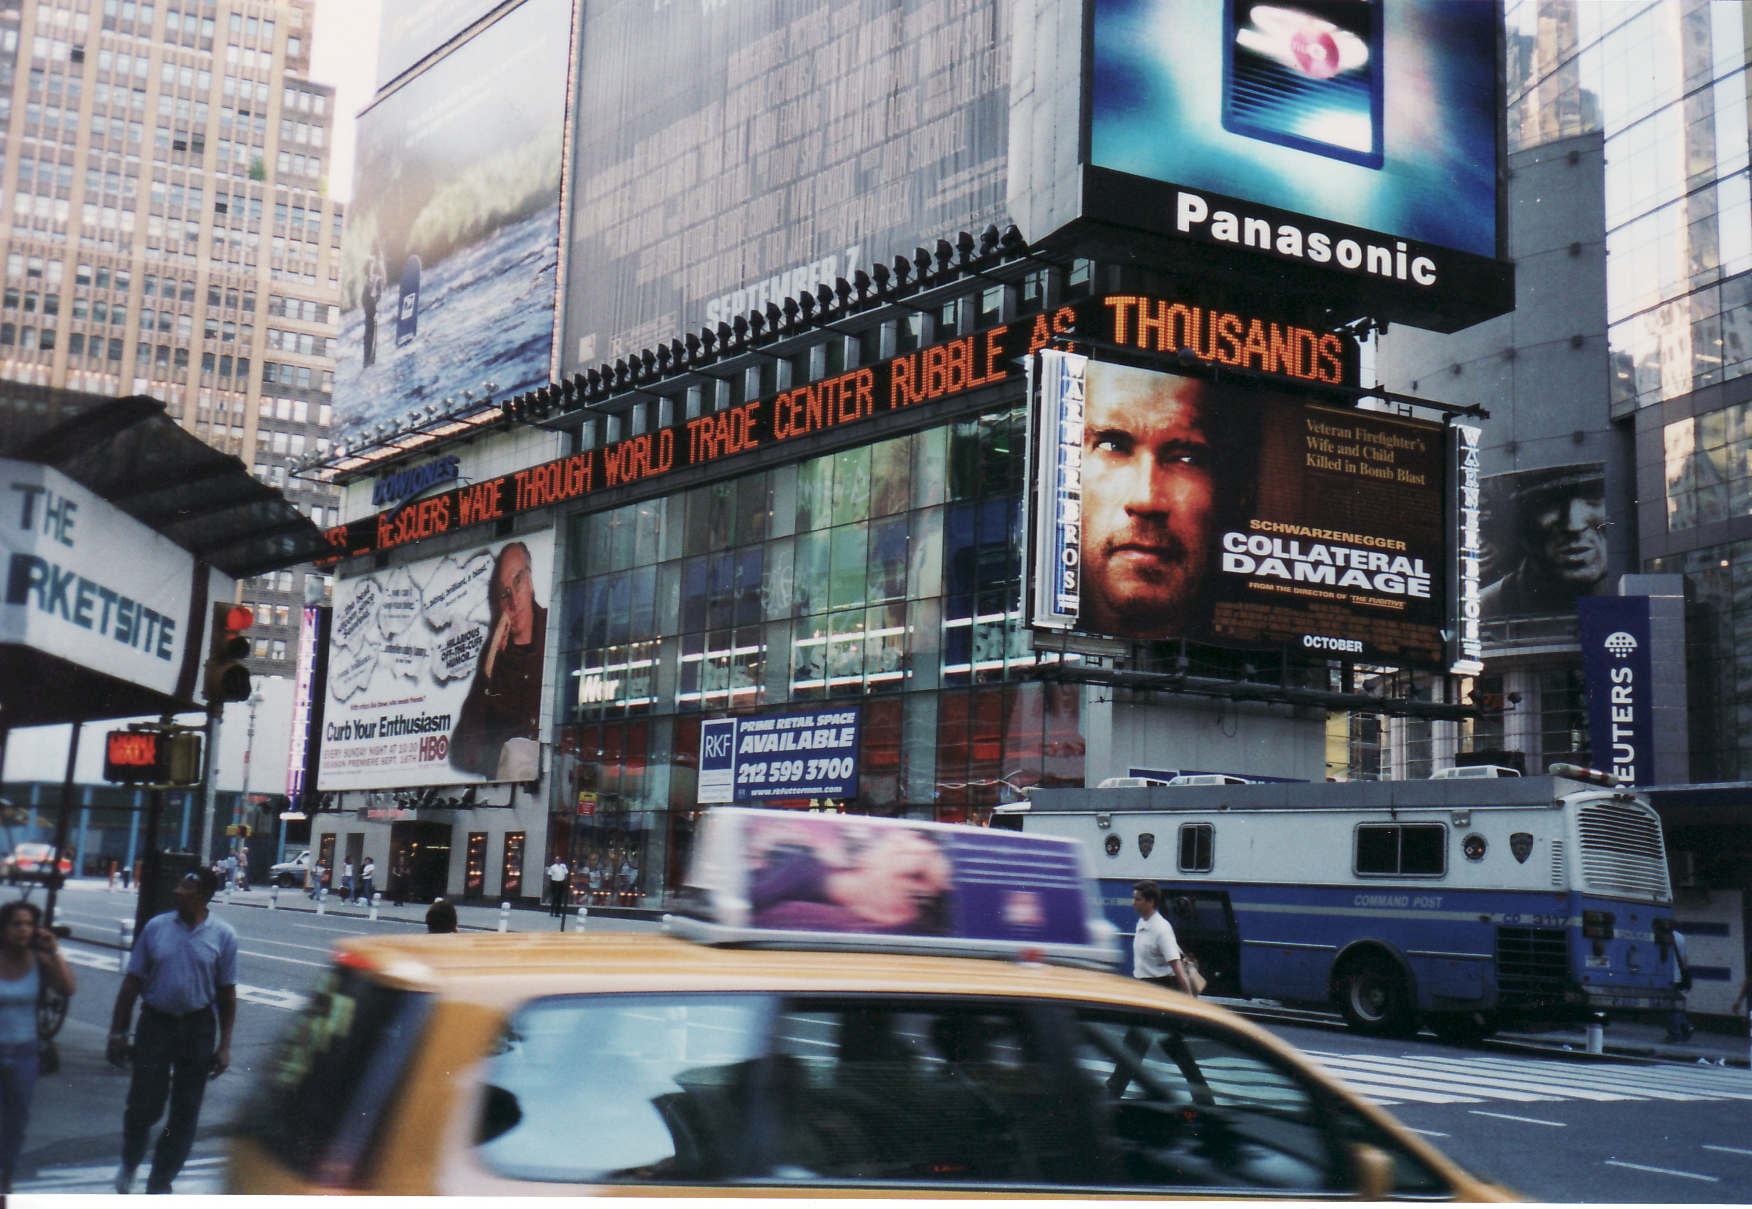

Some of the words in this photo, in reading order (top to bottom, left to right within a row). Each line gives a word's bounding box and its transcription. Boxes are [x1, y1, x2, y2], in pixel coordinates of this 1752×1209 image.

[1177, 192, 1436, 286] Panasonic
[706, 253, 837, 337] SEPTEMBER
[377, 496, 449, 549] RESCUERS
[459, 478, 505, 527] WADE
[515, 452, 593, 511] THROUGH
[604, 429, 674, 487] WORLD
[687, 402, 760, 464] TRADE
[773, 368, 874, 440] CENTER
[890, 326, 1008, 409] RUBBLE
[1028, 306, 1076, 356] AS
[1104, 296, 1342, 384] THOUSANDS
[1064, 357, 1086, 490] WARNER
[1306, 419, 1352, 439] Veteran
[1355, 427, 1426, 452] Firefighter's
[1306, 436, 1334, 453] Wife
[1337, 444, 1359, 457] and
[1363, 446, 1394, 463] Child
[1306, 453, 1342, 471] Killed
[1345, 459, 1356, 473] in
[1360, 462, 1394, 479] Bomb
[1397, 468, 1425, 485] Blast
[1461, 427, 1482, 548] WARNER
[9, 481, 78, 548] THE
[1249, 519, 1407, 551] SCHWARZENEGGER
[1222, 531, 1431, 579] COLLATERAL
[1222, 552, 1431, 598] DAMAGE
[1249, 581, 1274, 591] FROM
[1276, 584, 1292, 594] THE
[1293, 587, 1335, 599] DIRECTOR
[1337, 592, 1347, 600] OF
[6, 552, 176, 662] RKETSITE
[441, 636, 483, 662] OFF-THE-CUFF
[1303, 634, 1363, 653] OCTOBER
[327, 721, 352, 742] Curb
[353, 719, 377, 740] Your
[379, 711, 451, 738] Enthusiasm
[740, 720, 775, 733] PRIME
[776, 716, 815, 730] RETAIL
[816, 712, 856, 726] SPACE
[1610, 667, 1635, 789] EUTERS
[324, 748, 342, 759] EVERY
[343, 747, 367, 758] SUNDAY
[369, 744, 388, 756] NIGHT
[389, 744, 397, 753] AT
[399, 742, 418, 753] 10:30
[419, 735, 449, 762] HBO
[705, 734, 731, 758] RKF
[739, 727, 856, 754] AVAILABLE
[109, 749, 157, 765] WALK
[323, 760, 346, 769] SEASON
[348, 758, 379, 769] PREMIERE
[381, 756, 397, 765] SEPT.
[737, 762, 768, 784] 212
[768, 760, 804, 782] 599
[805, 757, 854, 781] 3700
[751, 786, 842, 796] www.rkfutterman.com
[1354, 894, 1409, 907] COMMAND
[1413, 896, 1443, 908] POST
[1503, 913, 1521, 924] CD
[1532, 914, 1570, 926] 3117
[1616, 929, 1651, 942] POLICE
